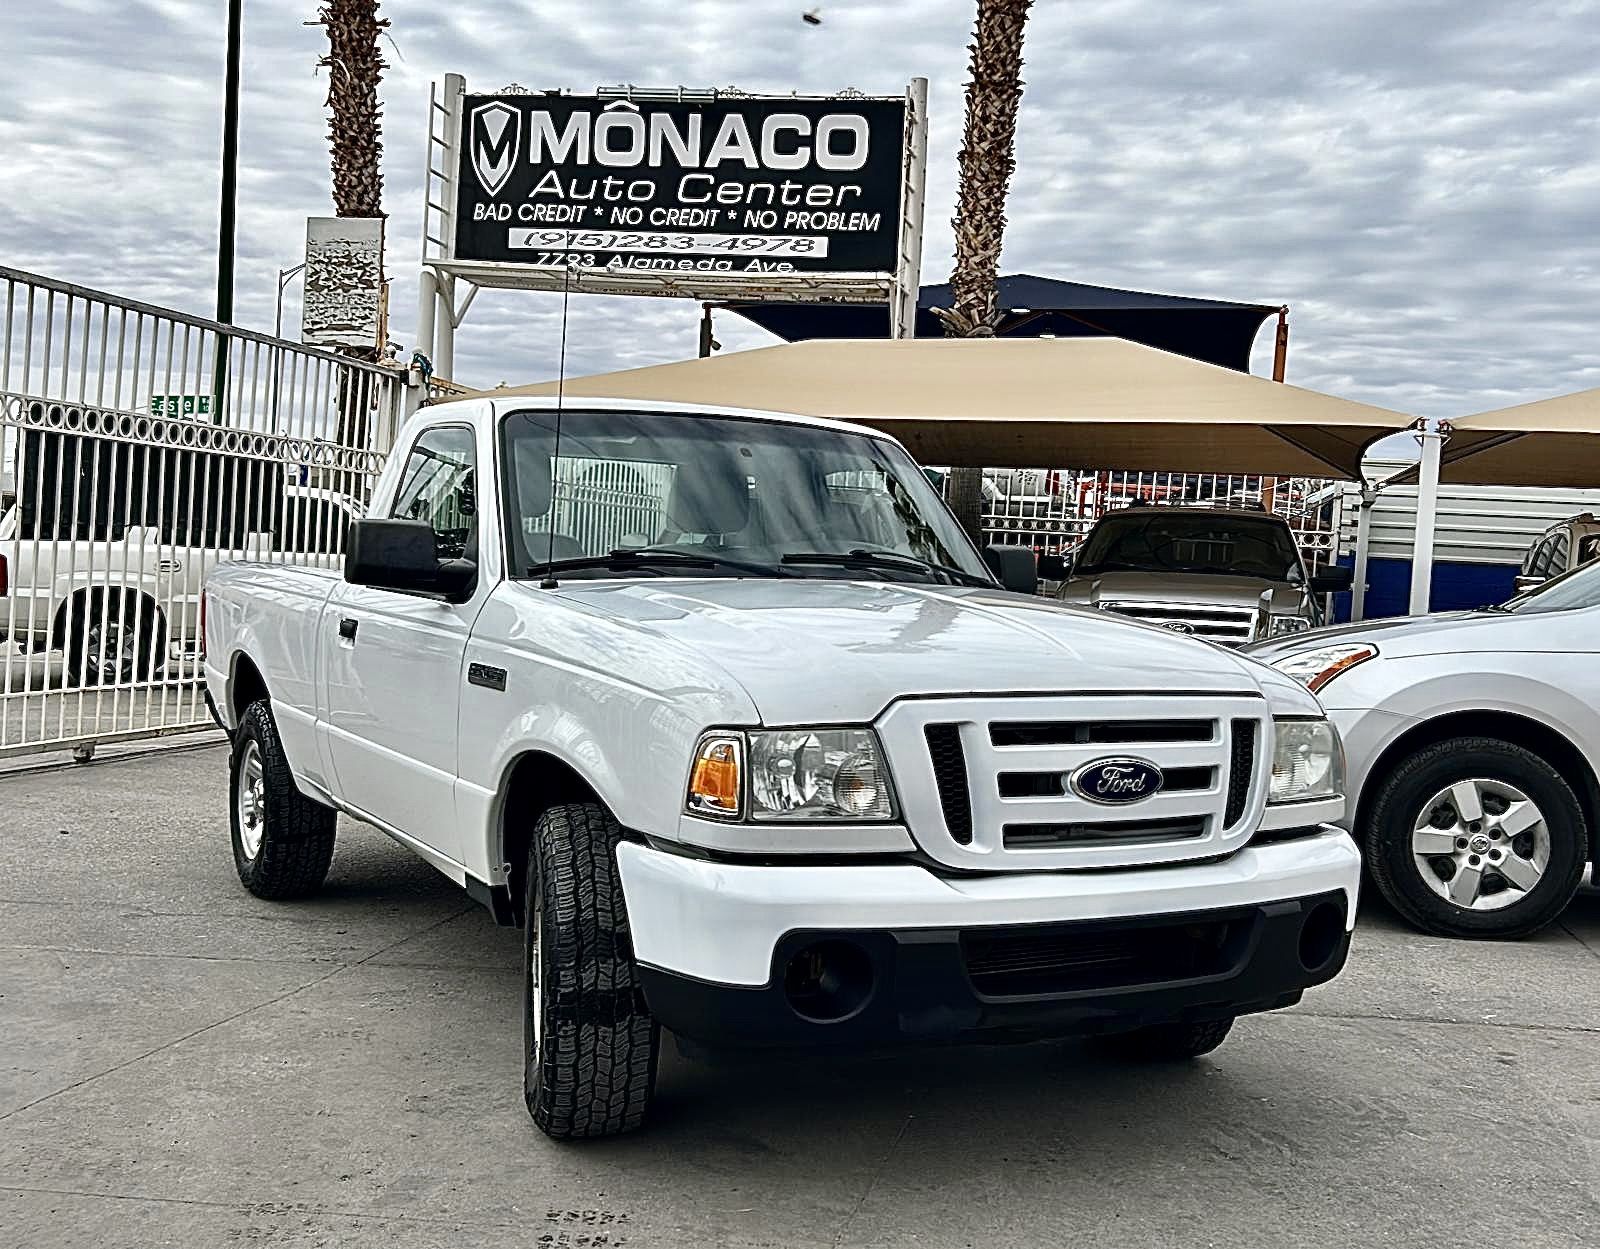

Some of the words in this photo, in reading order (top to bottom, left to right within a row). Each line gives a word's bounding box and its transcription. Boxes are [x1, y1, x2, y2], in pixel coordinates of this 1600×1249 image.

[530, 100, 870, 171] MÔNACO
[528, 169, 657, 201] Auto
[676, 173, 862, 207] Center
[473, 203, 512, 221] BAD
[517, 204, 587, 223] CREDIT
[610, 206, 643, 225] NO
[649, 208, 720, 227] CREDIT
[743, 209, 778, 229] NO
[783, 211, 881, 231] PROBLEM
[523, 231, 816, 252] (915)283-4978
[606, 255, 733, 271] Alameda
[1096, 766, 1147, 793] Ford
